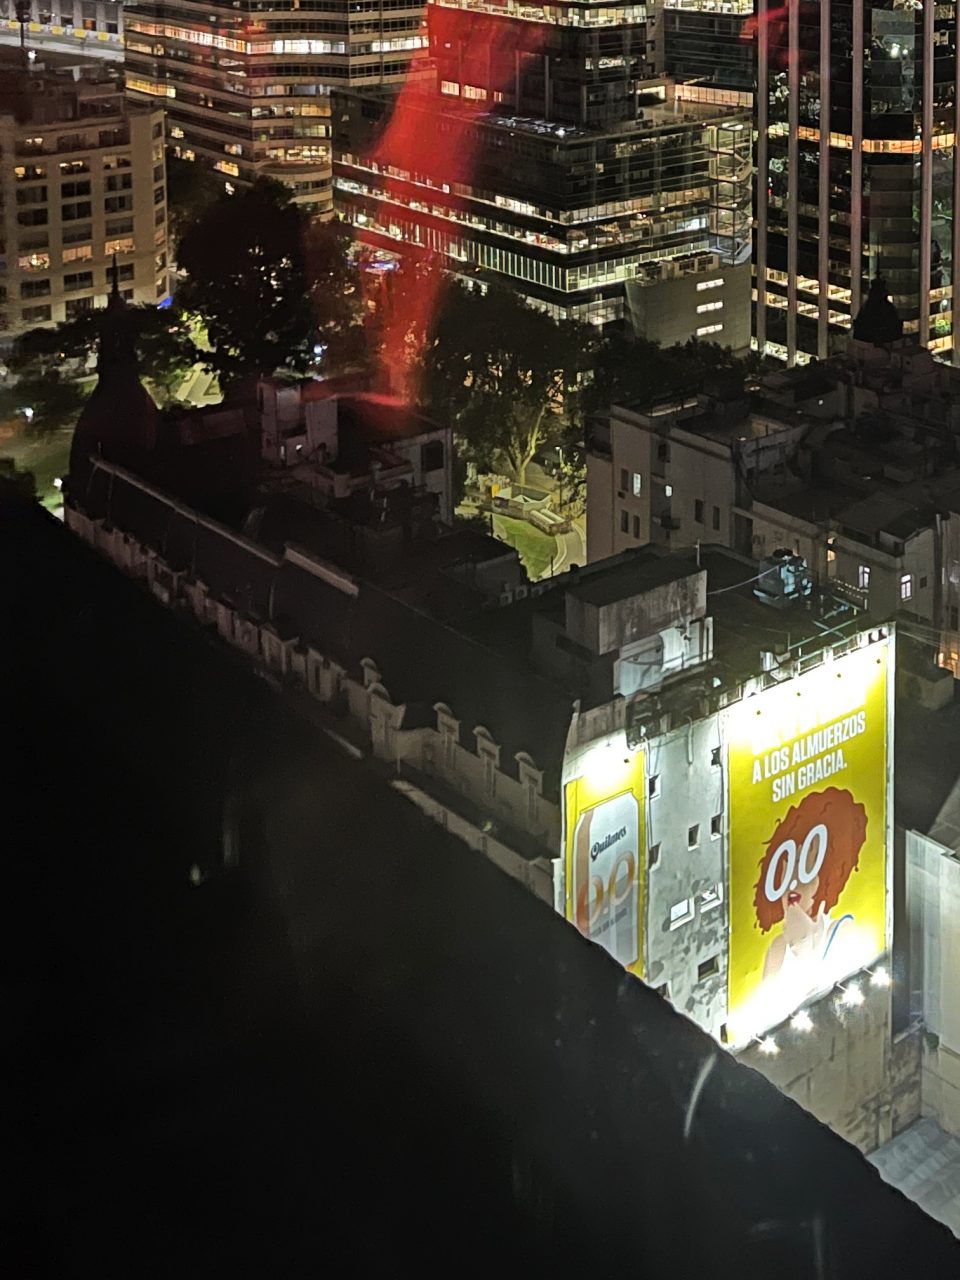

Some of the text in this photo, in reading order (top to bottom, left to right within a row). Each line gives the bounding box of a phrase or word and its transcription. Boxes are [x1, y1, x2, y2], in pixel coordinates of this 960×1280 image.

[753, 759, 762, 784] A
[764, 746, 790, 779] LOS
[792, 711, 866, 766] ALMUERZOS
[772, 748, 848, 803] SIN GRACIA.
[591, 825, 627, 862] Quilmes
[764, 824, 828, 902] 0.0
